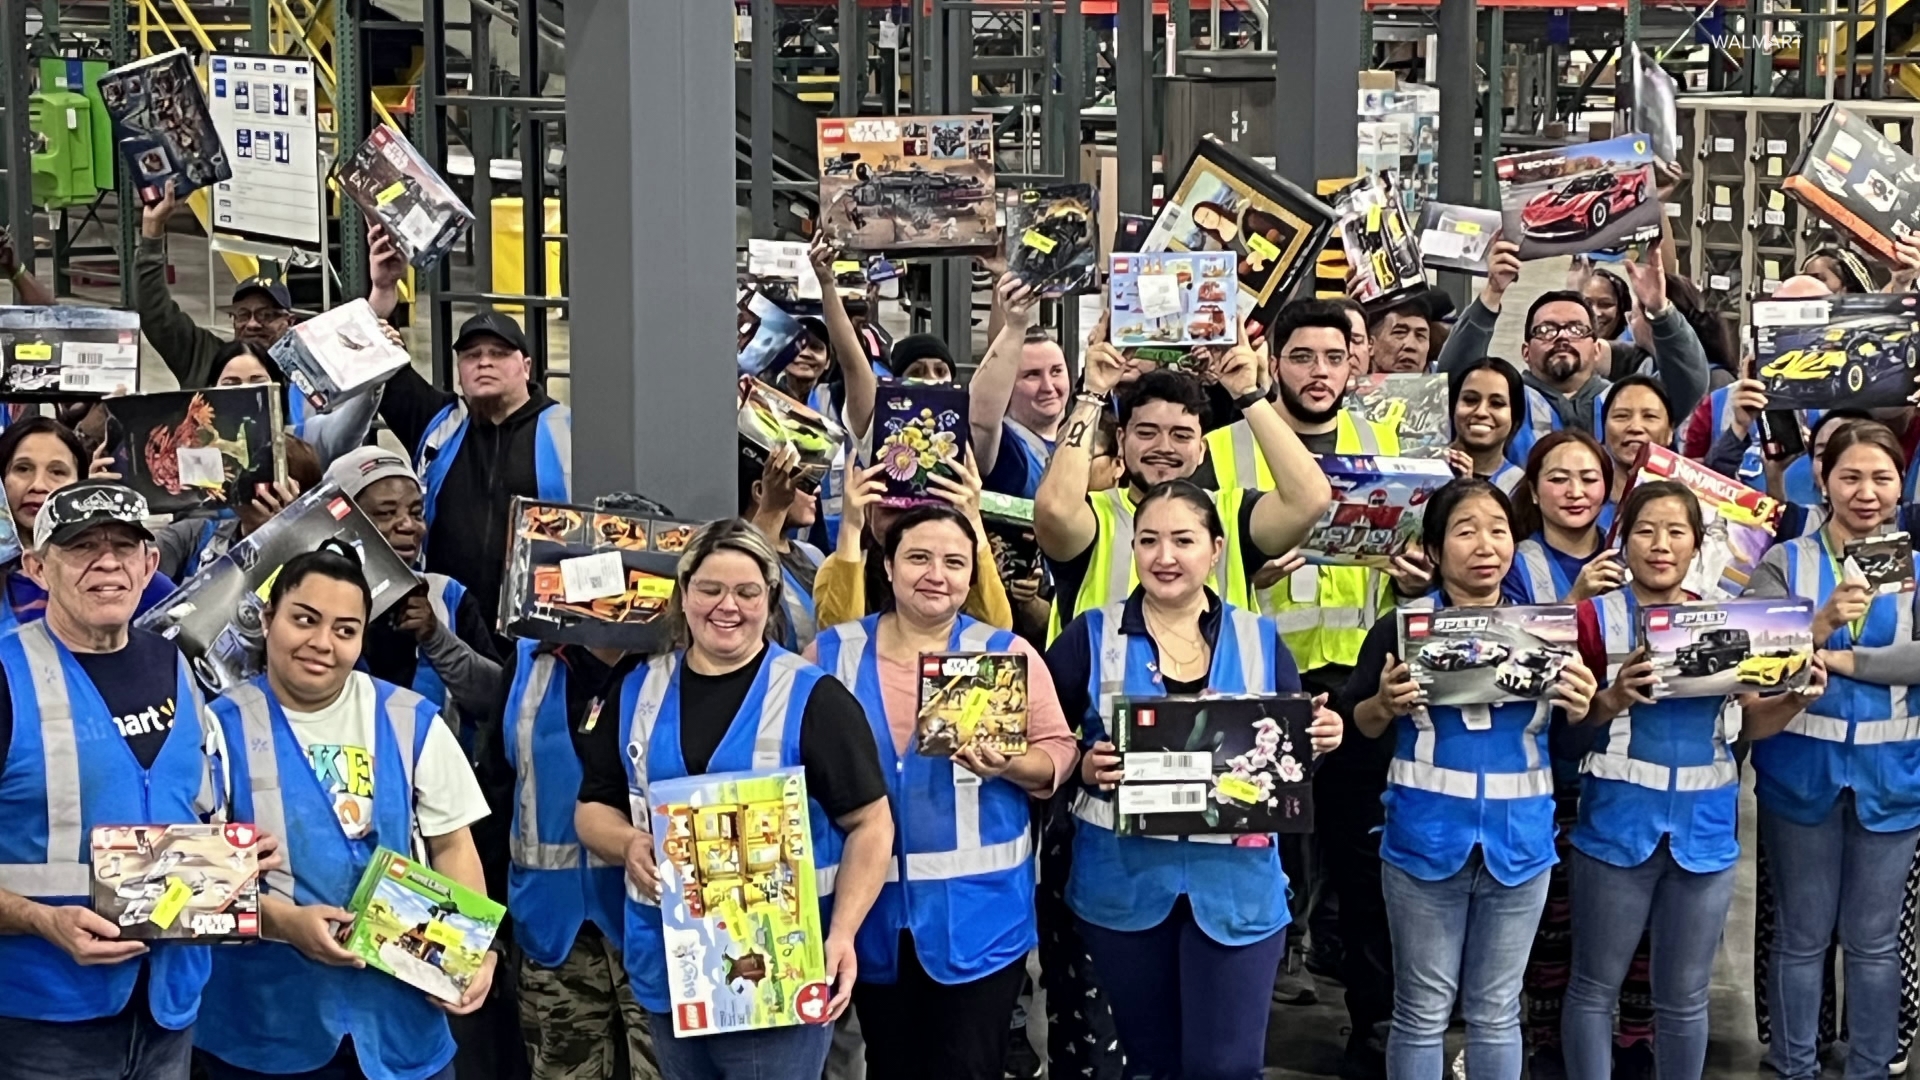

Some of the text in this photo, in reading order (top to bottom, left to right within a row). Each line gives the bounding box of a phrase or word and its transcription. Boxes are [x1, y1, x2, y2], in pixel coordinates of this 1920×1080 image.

[1669, 459, 1738, 505] NINJAGO
[1434, 616, 1489, 630] SPEED
[1674, 611, 1727, 625] SPEED
[305, 744, 374, 799] KE
